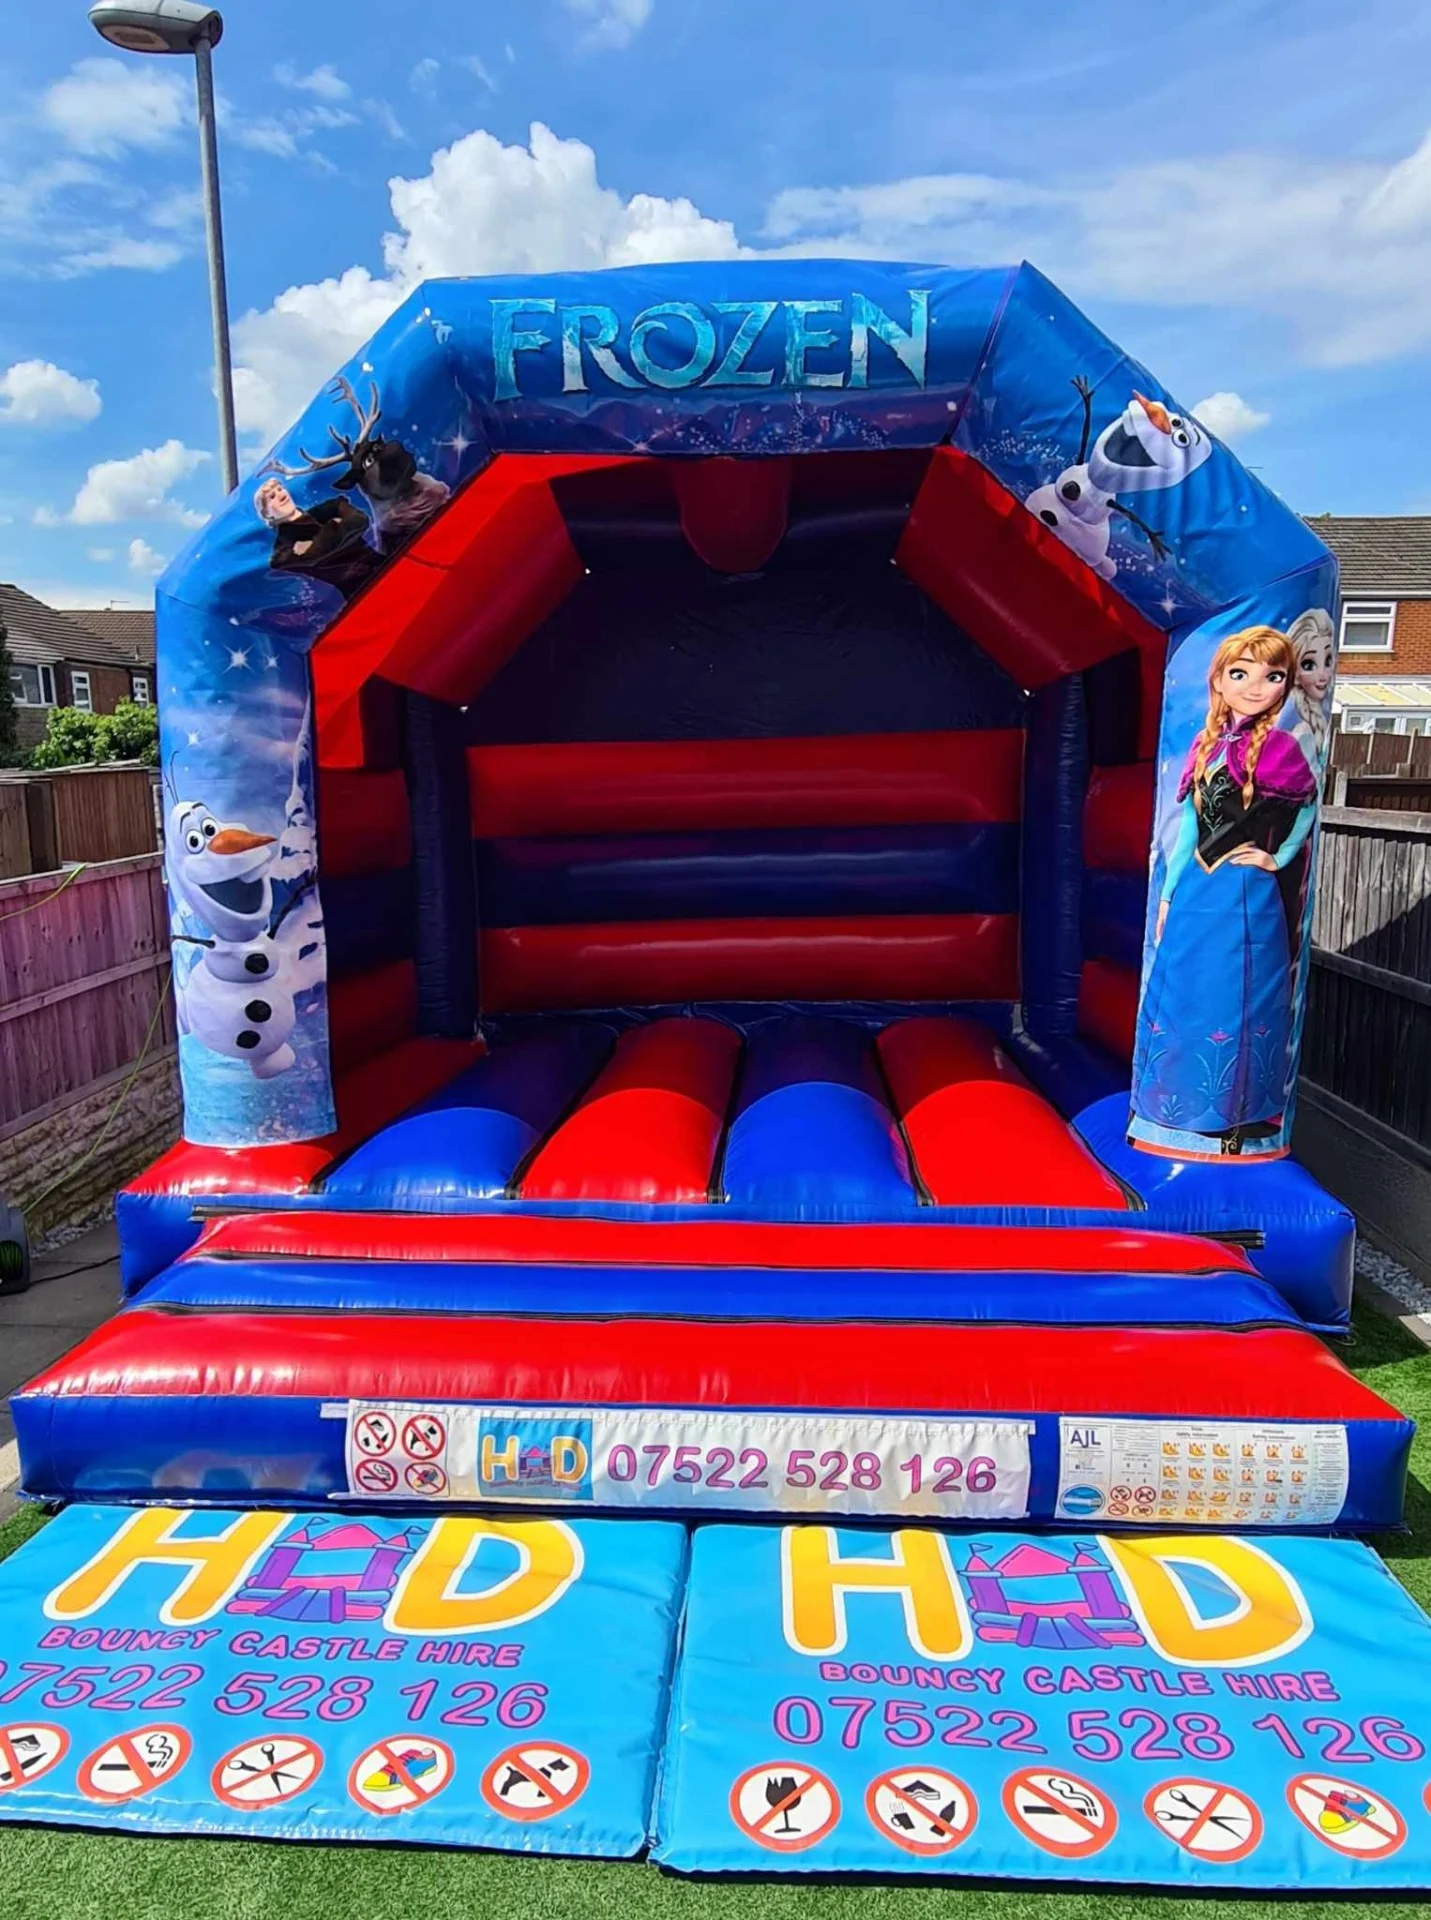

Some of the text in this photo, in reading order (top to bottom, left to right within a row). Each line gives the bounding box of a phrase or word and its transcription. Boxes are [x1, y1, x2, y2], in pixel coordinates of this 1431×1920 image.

[488, 289, 932, 400] FROZEN
[1070, 1430, 1101, 1449] AJL
[607, 1442, 997, 1494] 07522 528 126
[37, 1626, 525, 1668] BOUNCY CASTLE HIRE
[0, 1660, 549, 1728] 7522 528 126
[819, 1661, 1341, 1702] BOUNCY CASTLE HIRE
[773, 1695, 1426, 1763] 07522 528 126
